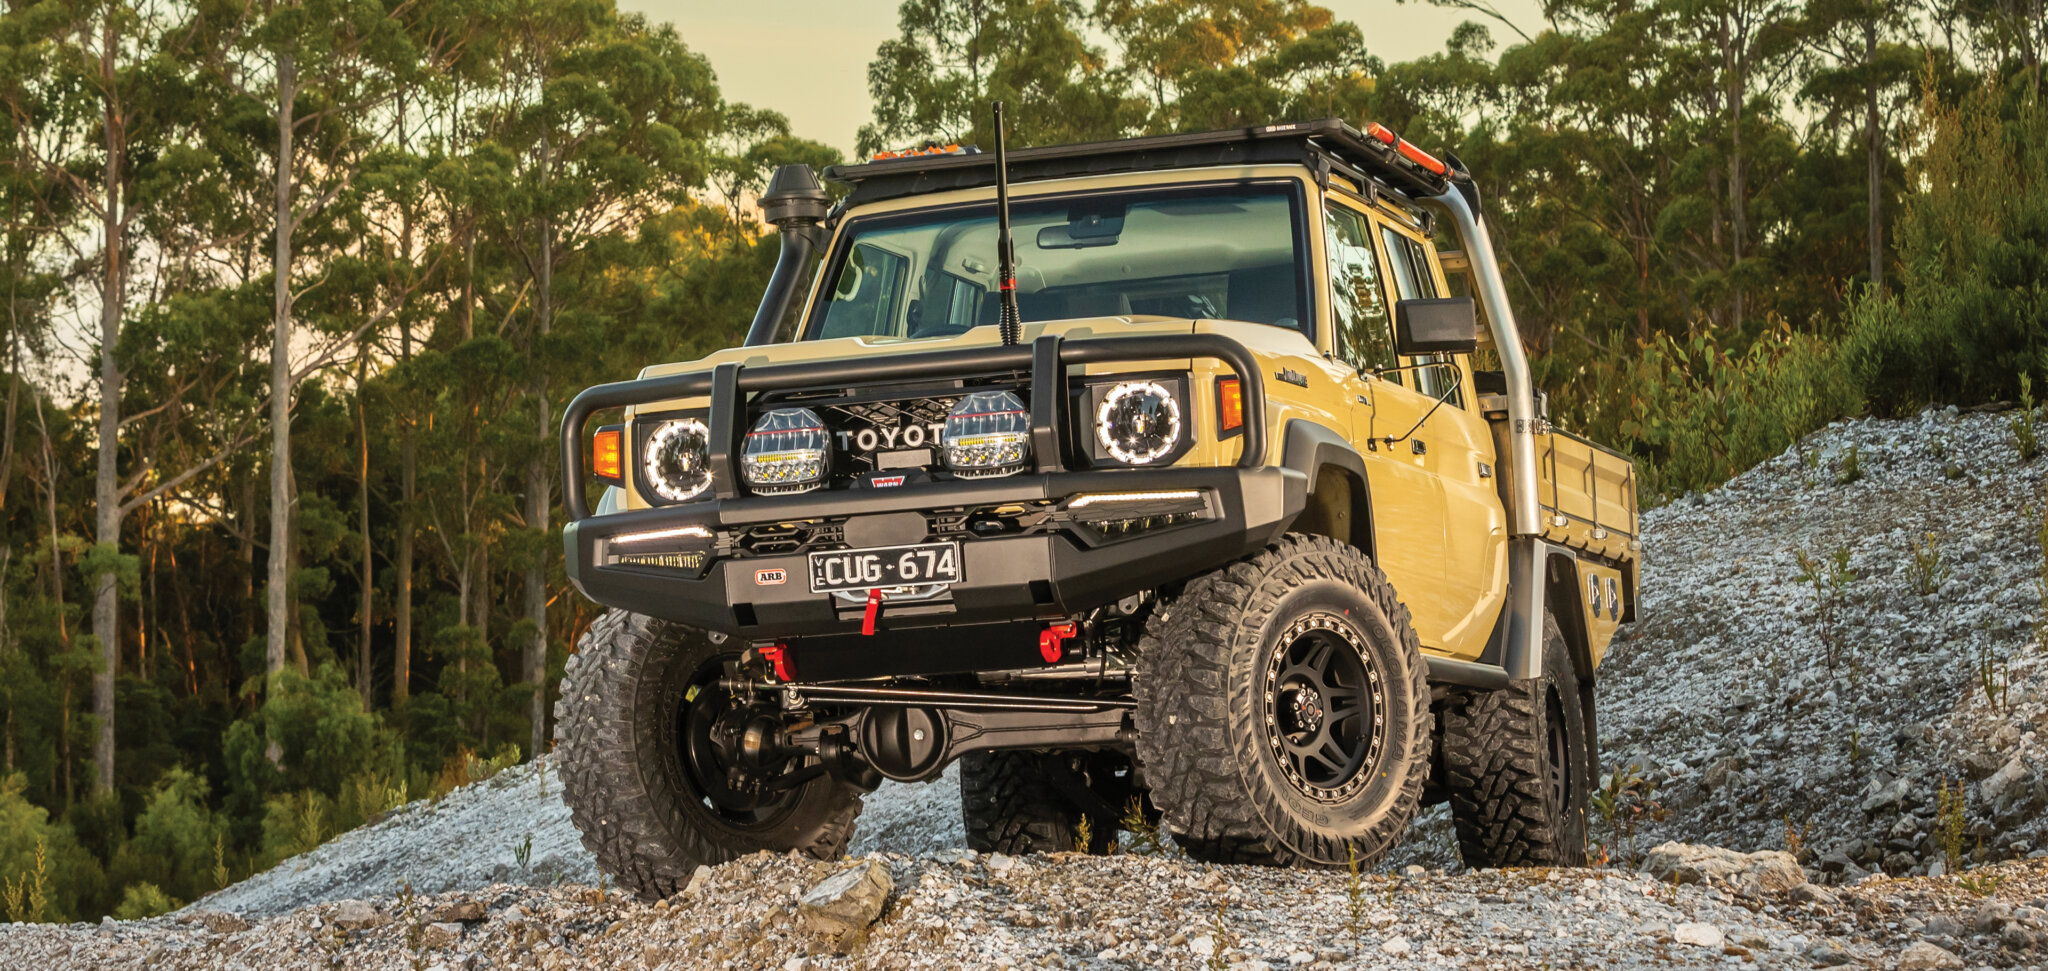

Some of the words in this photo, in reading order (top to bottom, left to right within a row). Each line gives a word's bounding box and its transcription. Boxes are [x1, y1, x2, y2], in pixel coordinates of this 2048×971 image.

[836, 423, 946, 451] TOYOT
[760, 572, 783, 582] ARB
[814, 556, 826, 586] VIC
[825, 554, 881, 585] CUG
[899, 549, 956, 579] 674
